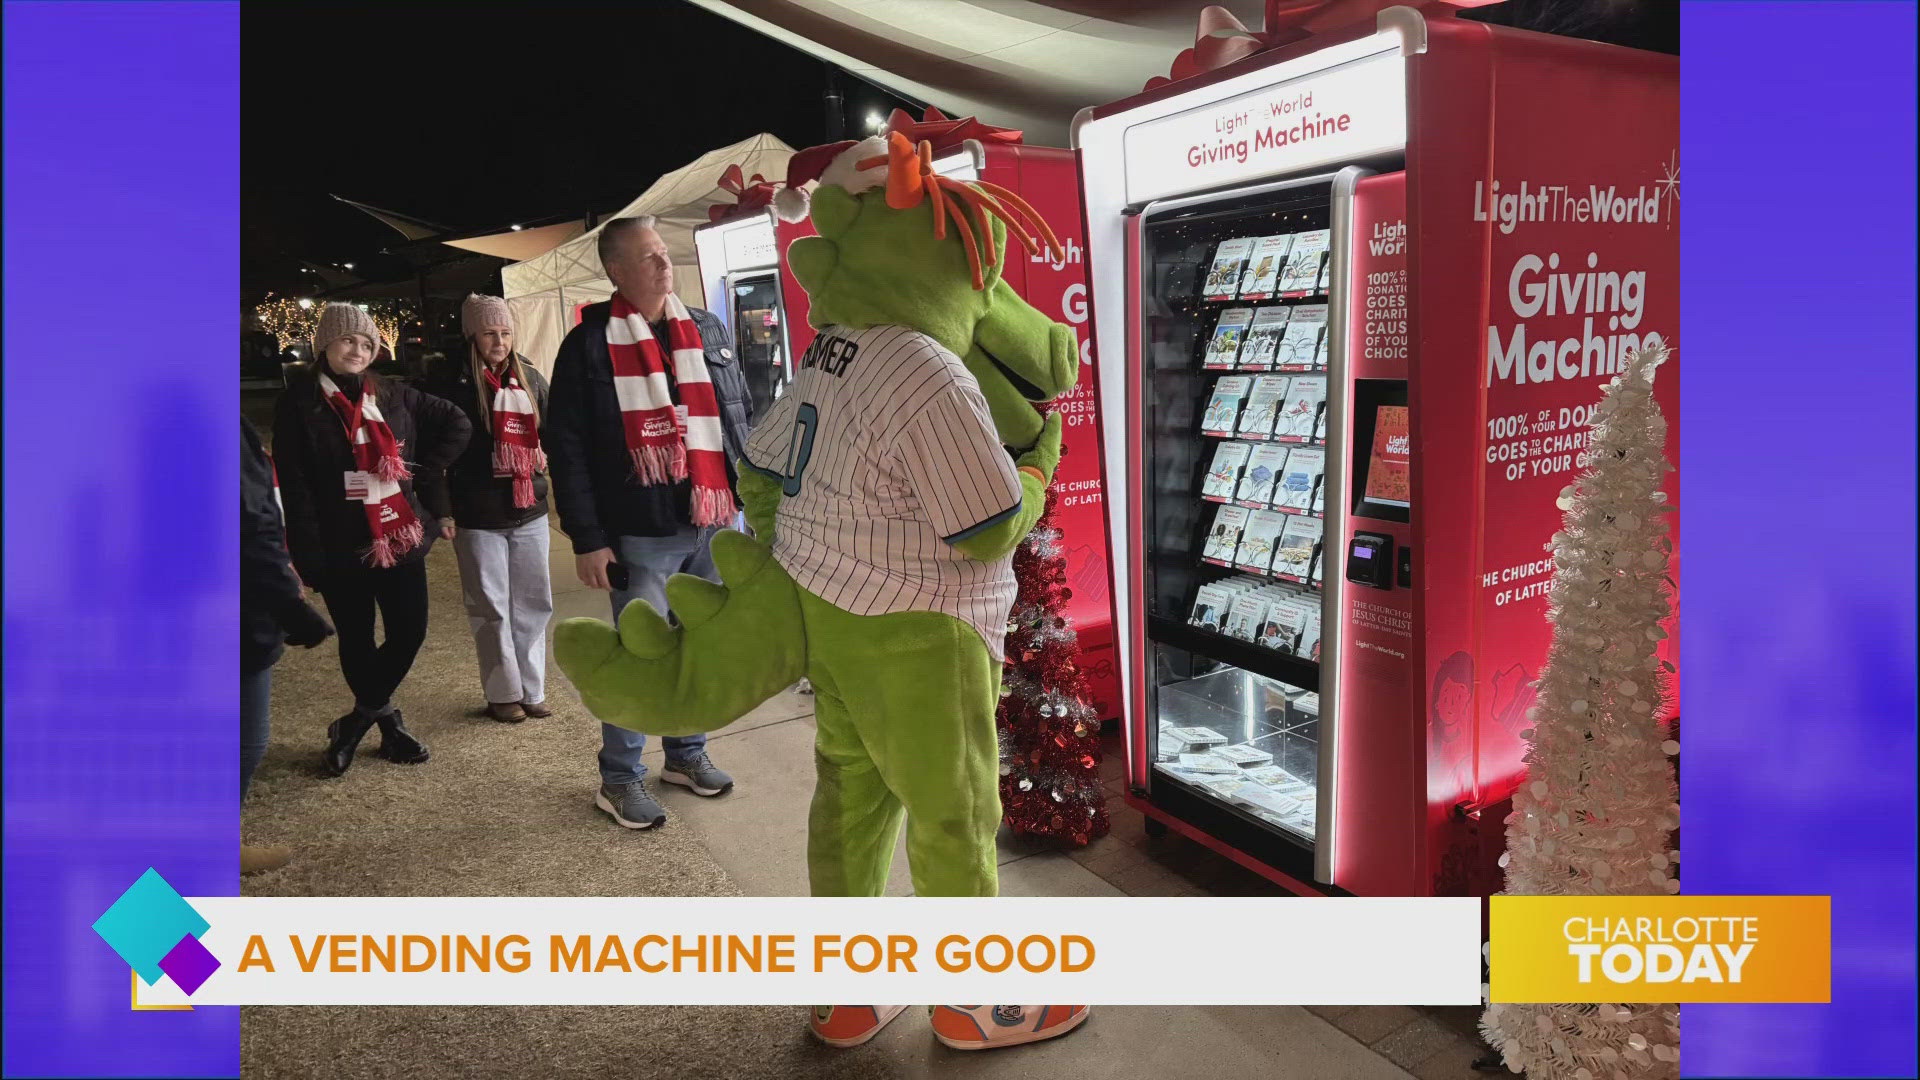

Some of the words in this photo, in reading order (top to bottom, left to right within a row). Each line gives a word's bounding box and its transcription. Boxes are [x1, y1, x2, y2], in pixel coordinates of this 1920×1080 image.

[1187, 138, 1248, 168] Giving
[1254, 112, 1351, 153] Machine
[1031, 237, 1083, 271] Ligh
[1369, 239, 1407, 257] Wor
[1367, 271, 1398, 285] 100%
[1508, 252, 1647, 330] Giving
[1366, 294, 1406, 309] GOES
[1365, 320, 1407, 335] CAUS
[1365, 336, 1381, 347] OF
[644, 421, 671, 430] Giving
[1068, 414, 1084, 426] OF
[1487, 412, 1529, 440] 100%
[1538, 409, 1551, 422] OF
[1531, 420, 1556, 434] YOUR
[641, 426, 677, 437] Machine
[1486, 440, 1528, 463] GOES
[1531, 438, 1541, 448] TO
[1529, 447, 1541, 457] THE
[1506, 461, 1527, 481] OF
[1531, 454, 1572, 477] YOUR
[1064, 496, 1078, 506] OF
[1482, 571, 1499, 588] HE
[1502, 558, 1552, 583] CHURCH
[1495, 590, 1513, 606] OF
[1352, 600, 1367, 610] THE
[1368, 603, 1401, 617] CHURCH
[1352, 608, 1376, 622] JESUS
[1377, 614, 1413, 631] CHRIST
